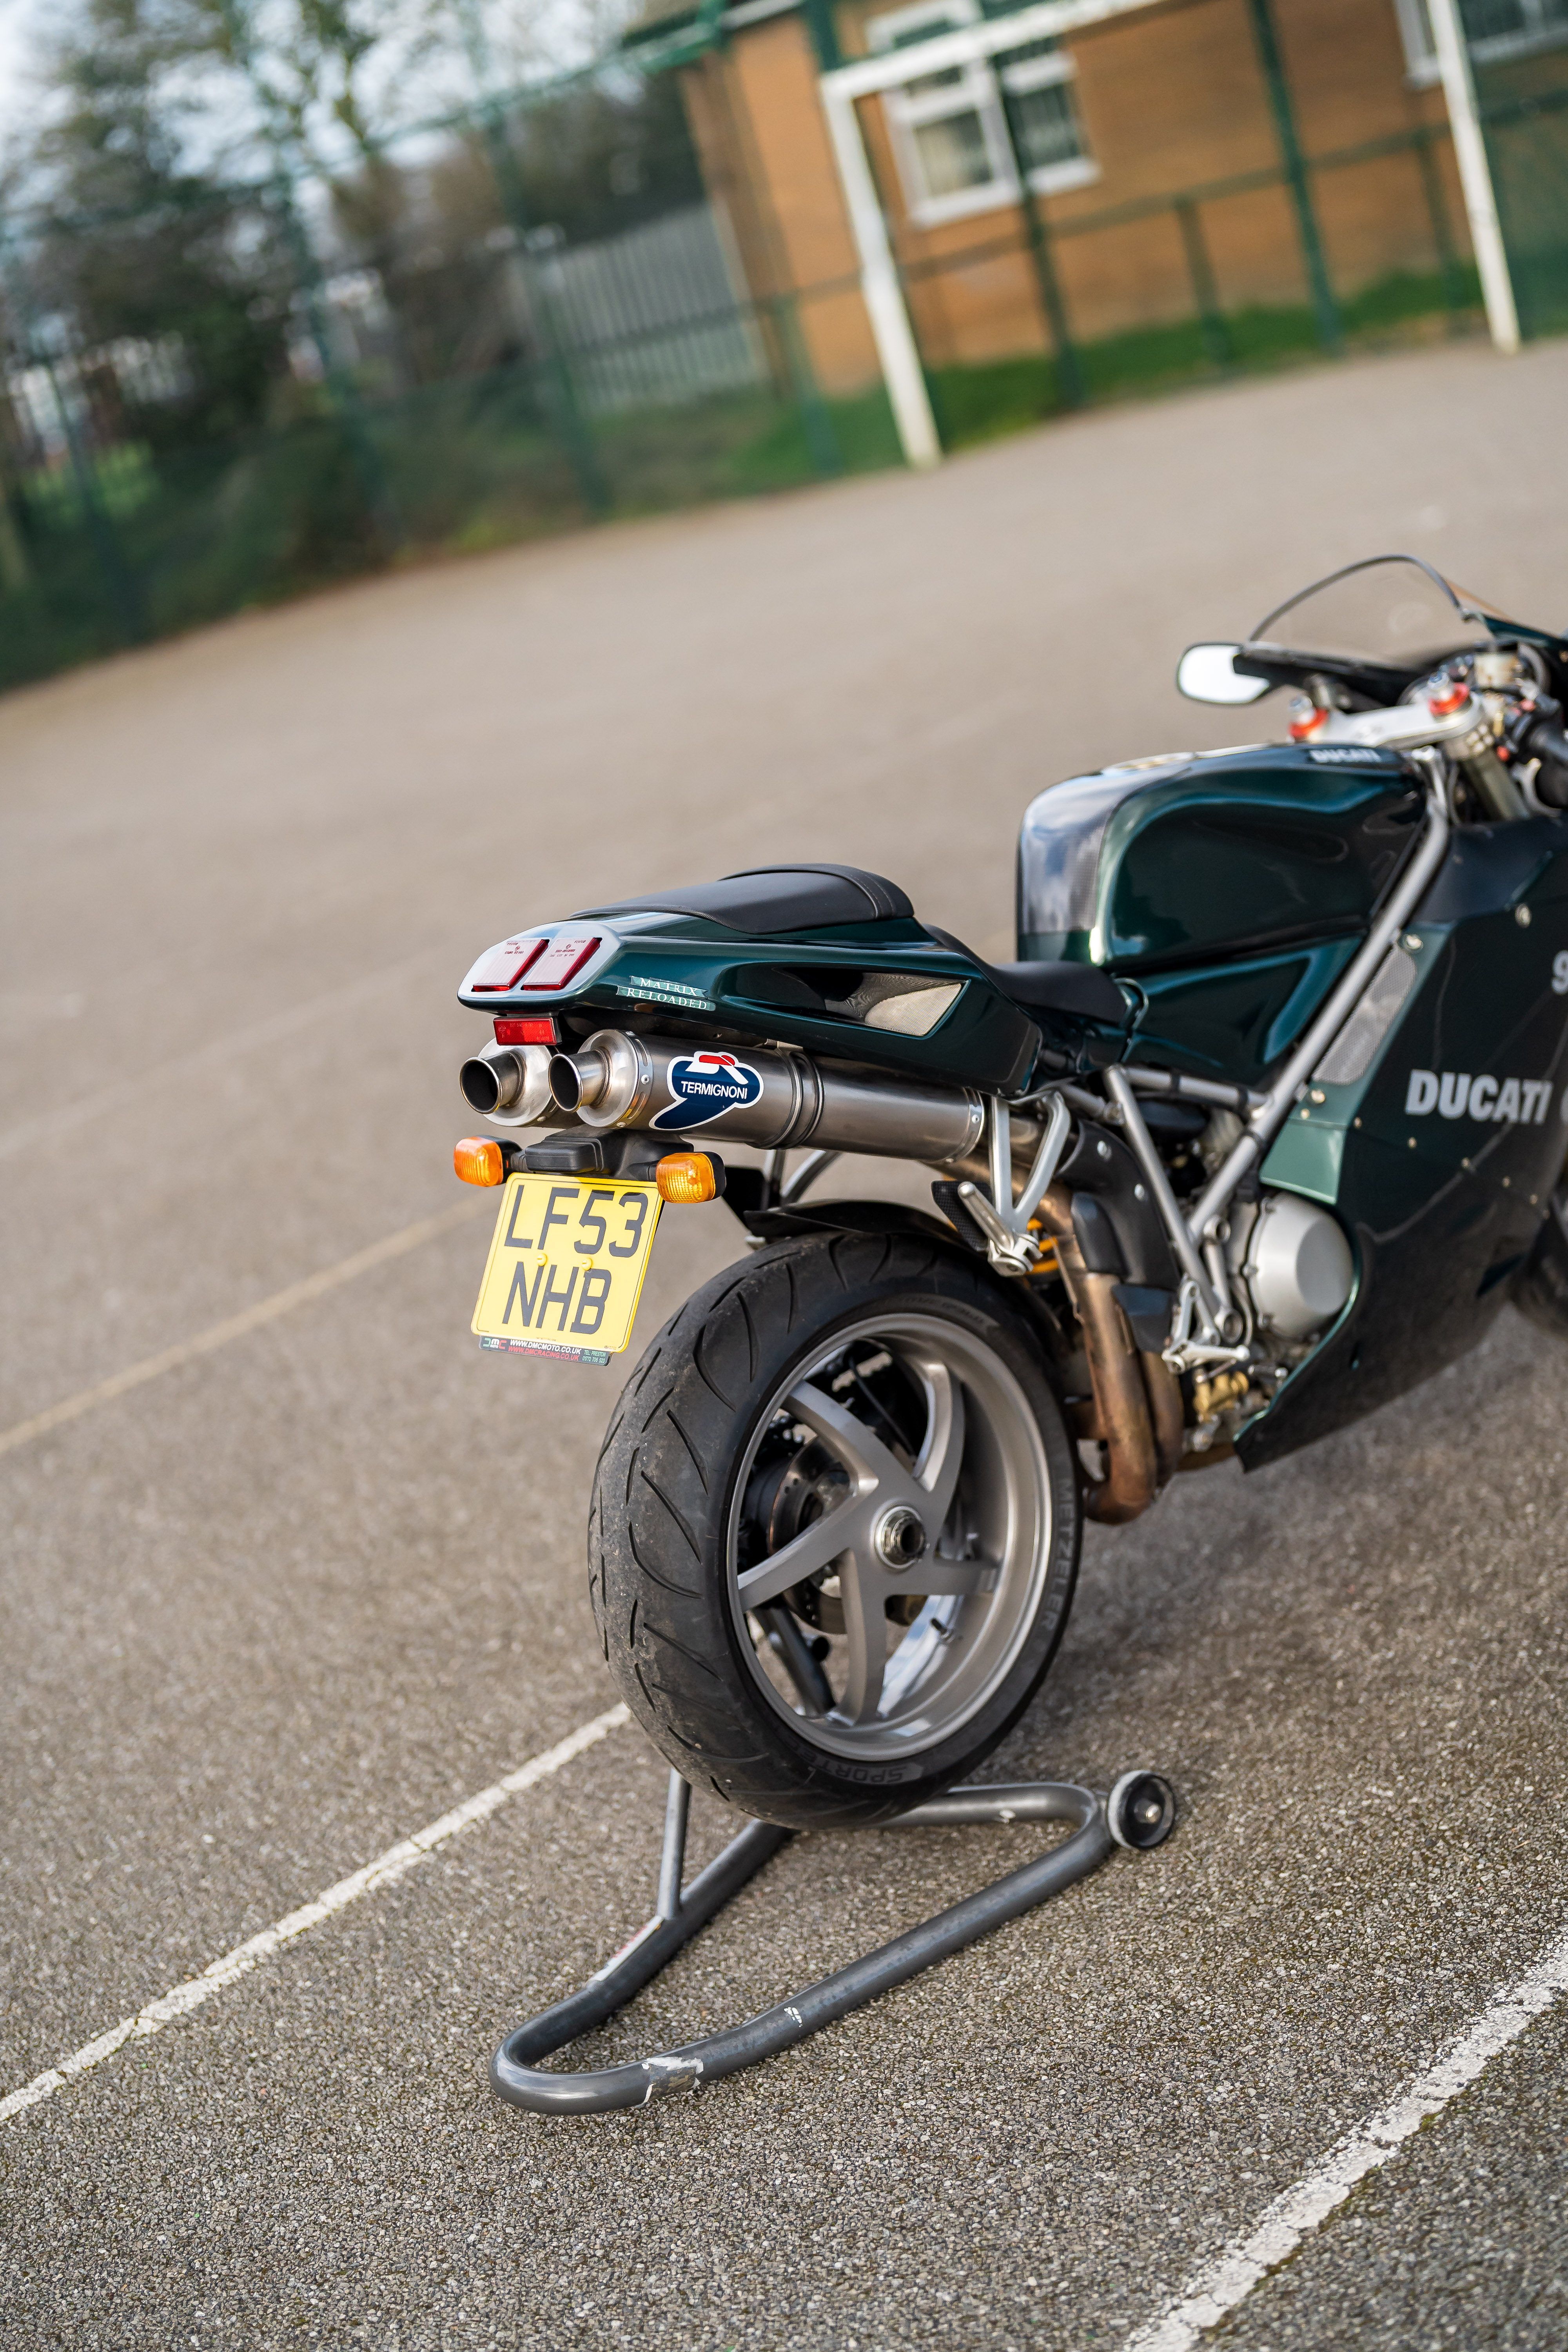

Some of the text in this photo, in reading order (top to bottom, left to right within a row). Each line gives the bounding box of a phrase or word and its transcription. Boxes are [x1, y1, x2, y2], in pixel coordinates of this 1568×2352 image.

[641, 978, 698, 996] MATRIX
[626, 988, 707, 1010] RELOADED
[681, 1081, 748, 1100] TERMIGNONI
[1405, 1069, 1553, 1125] DUCATI
[504, 1185, 649, 1258] LF53
[502, 1261, 612, 1335] NHB
[508, 1346, 580, 1361] WWW.DMCRACING.CO.UK
[510, 1339, 582, 1355] WWW.DMCMOTO.CO.UK
